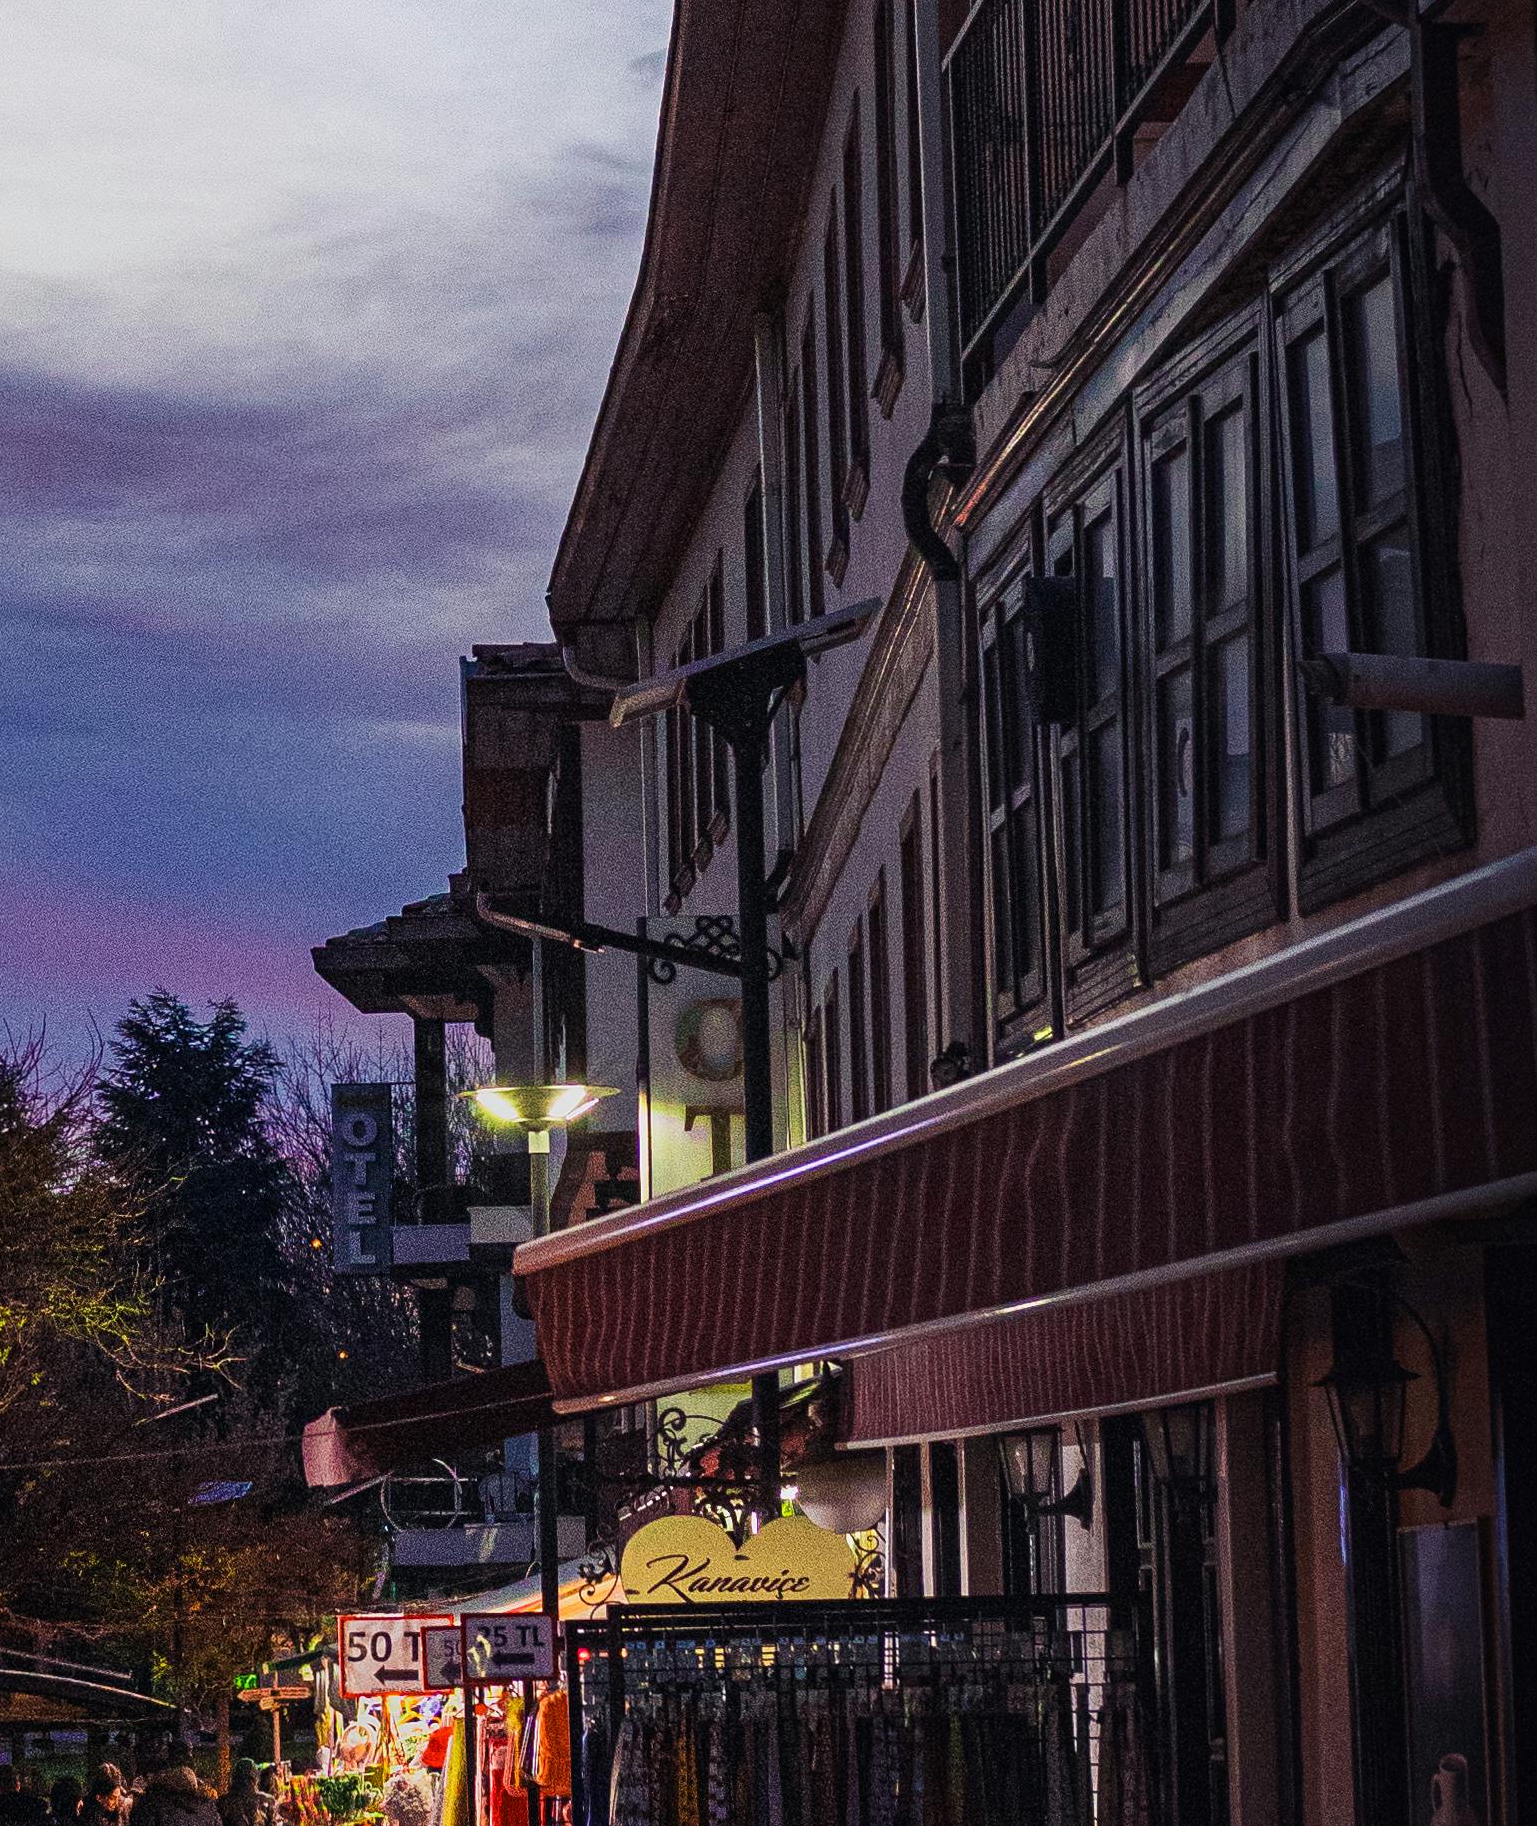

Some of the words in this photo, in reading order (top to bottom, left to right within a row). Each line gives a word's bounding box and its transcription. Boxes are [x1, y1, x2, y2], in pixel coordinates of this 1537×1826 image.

[341, 1112, 378, 1265] OTEL
[646, 1554, 810, 1604] Kanaviçe
[347, 1631, 392, 1663] 50
[404, 1631, 420, 1663] T
[515, 1625, 544, 1647] TL
